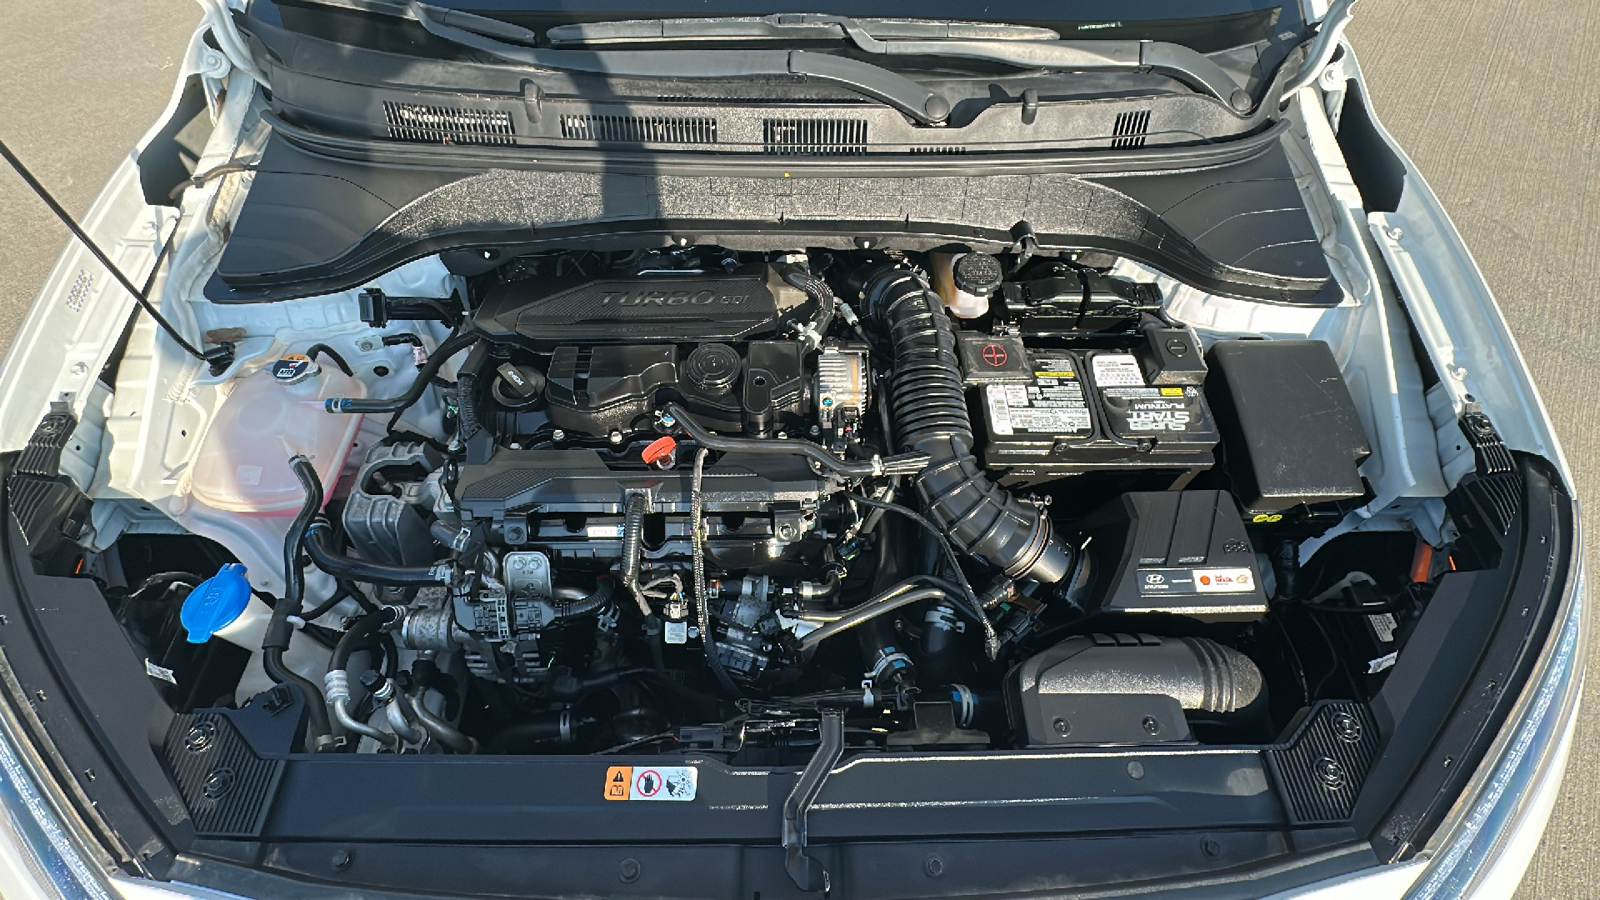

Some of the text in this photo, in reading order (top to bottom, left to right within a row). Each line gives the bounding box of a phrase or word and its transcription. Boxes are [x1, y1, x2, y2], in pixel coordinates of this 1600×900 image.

[600, 290, 716, 306] TURBO
[1127, 411, 1190, 423] START
[1129, 421, 1186, 431] SUPER
